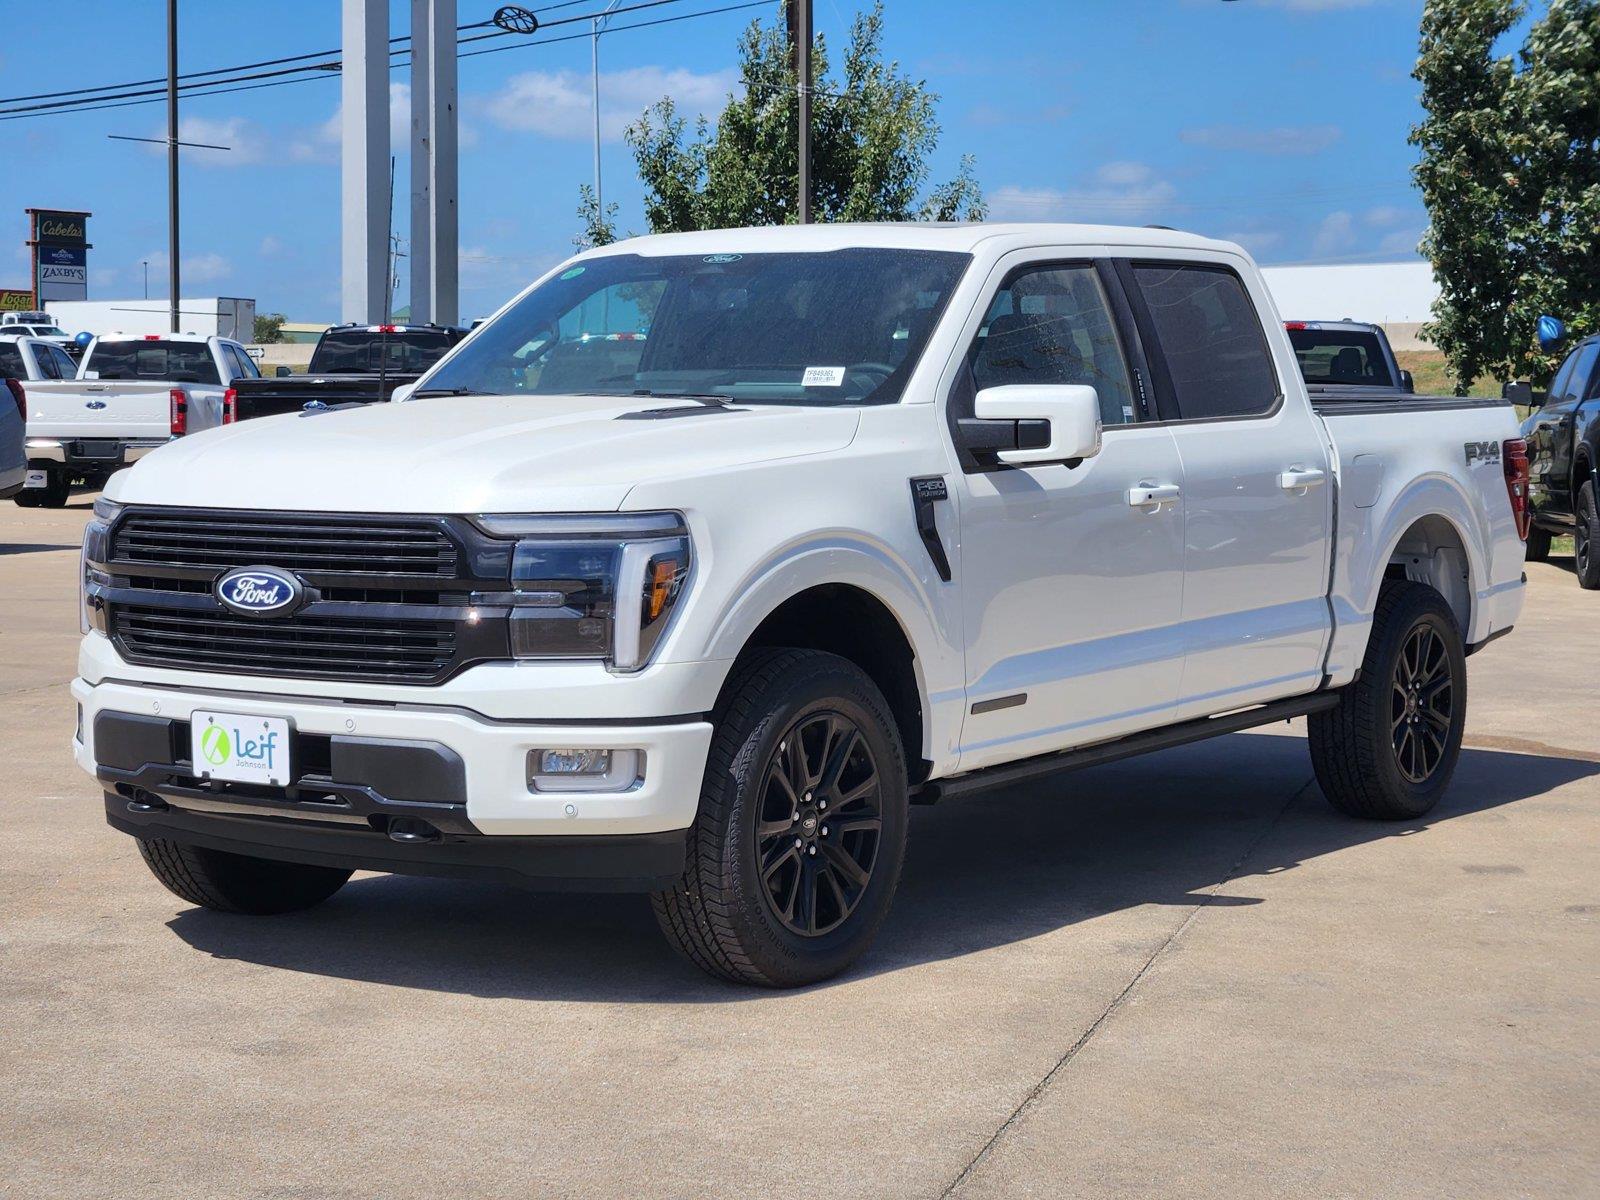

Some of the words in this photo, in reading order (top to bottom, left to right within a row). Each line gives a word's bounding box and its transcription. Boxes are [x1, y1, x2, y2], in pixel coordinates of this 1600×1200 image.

[41, 220, 83, 238] Cabela's
[42, 267, 84, 280] ZAXBY'S
[1464, 441, 1500, 467] FX4
[232, 576, 280, 605] Ford
[233, 728, 278, 770] leif
[235, 759, 267, 769] Johnson
